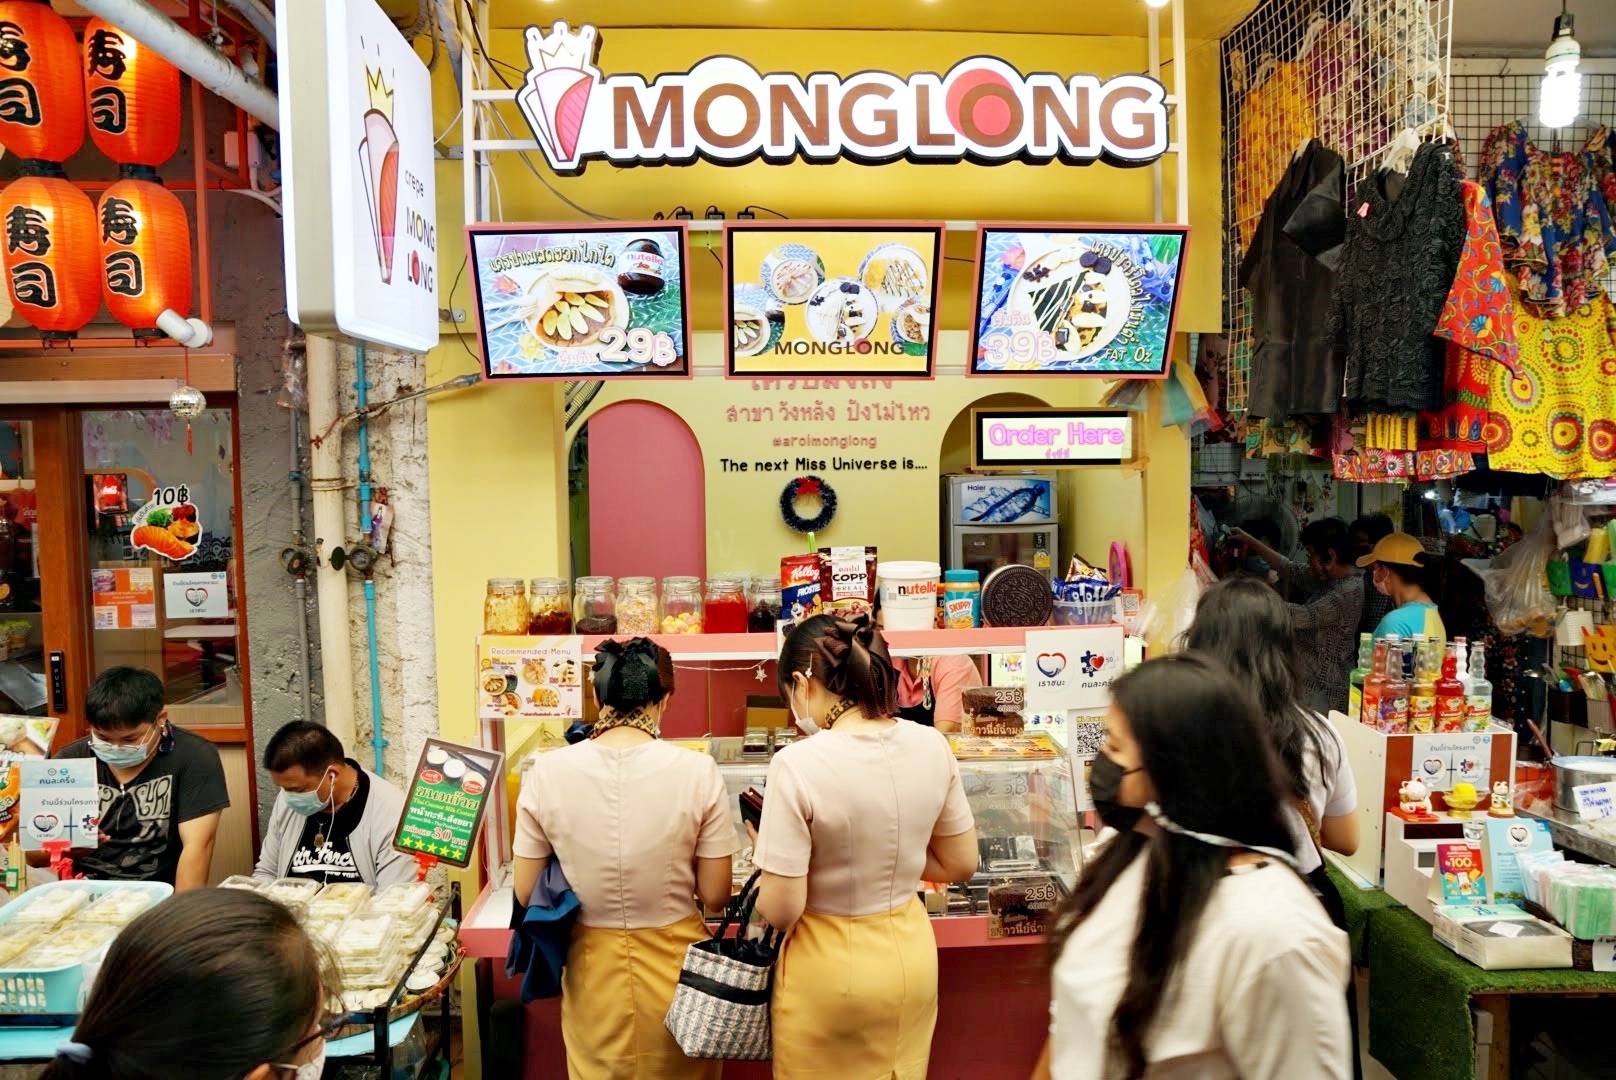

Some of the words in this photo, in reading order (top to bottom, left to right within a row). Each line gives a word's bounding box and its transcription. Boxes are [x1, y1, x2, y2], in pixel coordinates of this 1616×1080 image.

[613, 82, 1156, 150] MONGLONG
[405, 170, 424, 198] crepe
[406, 207, 435, 252] MONG
[627, 253, 664, 266] nutella
[407, 250, 433, 293] LONG
[774, 338, 905, 355] MONGLONG
[1104, 349, 1127, 362] FAT
[1133, 346, 1153, 363] 0%
[726, 404, 773, 423] สาขา
[779, 400, 836, 422] วังหลัง
[847, 399, 931, 422] ปังไม่ไหว
[772, 434, 877, 449] #aroimonglong
[989, 422, 1060, 446] Order
[1068, 422, 1125, 445] Here
[720, 459, 748, 472] The
[755, 459, 789, 471] next
[795, 457, 827, 471] Miss
[833, 457, 897, 471] Universe
[791, 564, 821, 580] Kellog
[832, 573, 868, 582] COPP
[898, 581, 937, 596] nutella
[948, 600, 971, 613] SKIPPY
[491, 648, 548, 656] Recommended
[1038, 680, 1065, 688] เราชนะ
[1081, 676, 1113, 689] คนละครึ่
[39, 775, 76, 785] คนละครึ่ง
[134, 775, 170, 817] CURL
[431, 826, 453, 843] 30
[1450, 857, 1473, 869] 100
